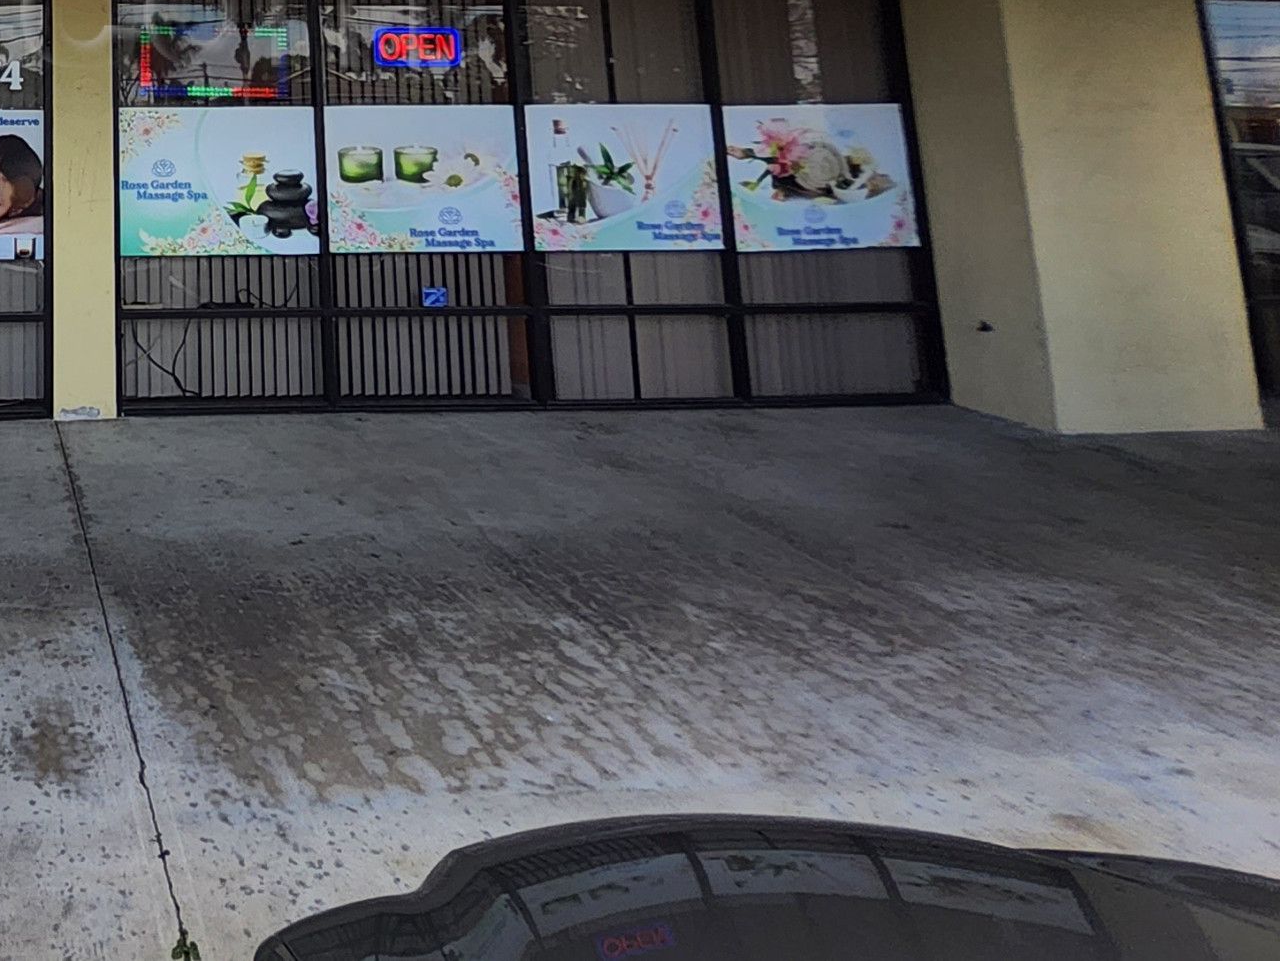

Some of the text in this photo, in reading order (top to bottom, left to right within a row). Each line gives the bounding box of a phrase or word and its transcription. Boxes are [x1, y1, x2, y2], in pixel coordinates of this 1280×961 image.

[379, 32, 455, 61] OPEN
[121, 180, 192, 190] Rose Garden
[136, 190, 208, 202] Massage Spa
